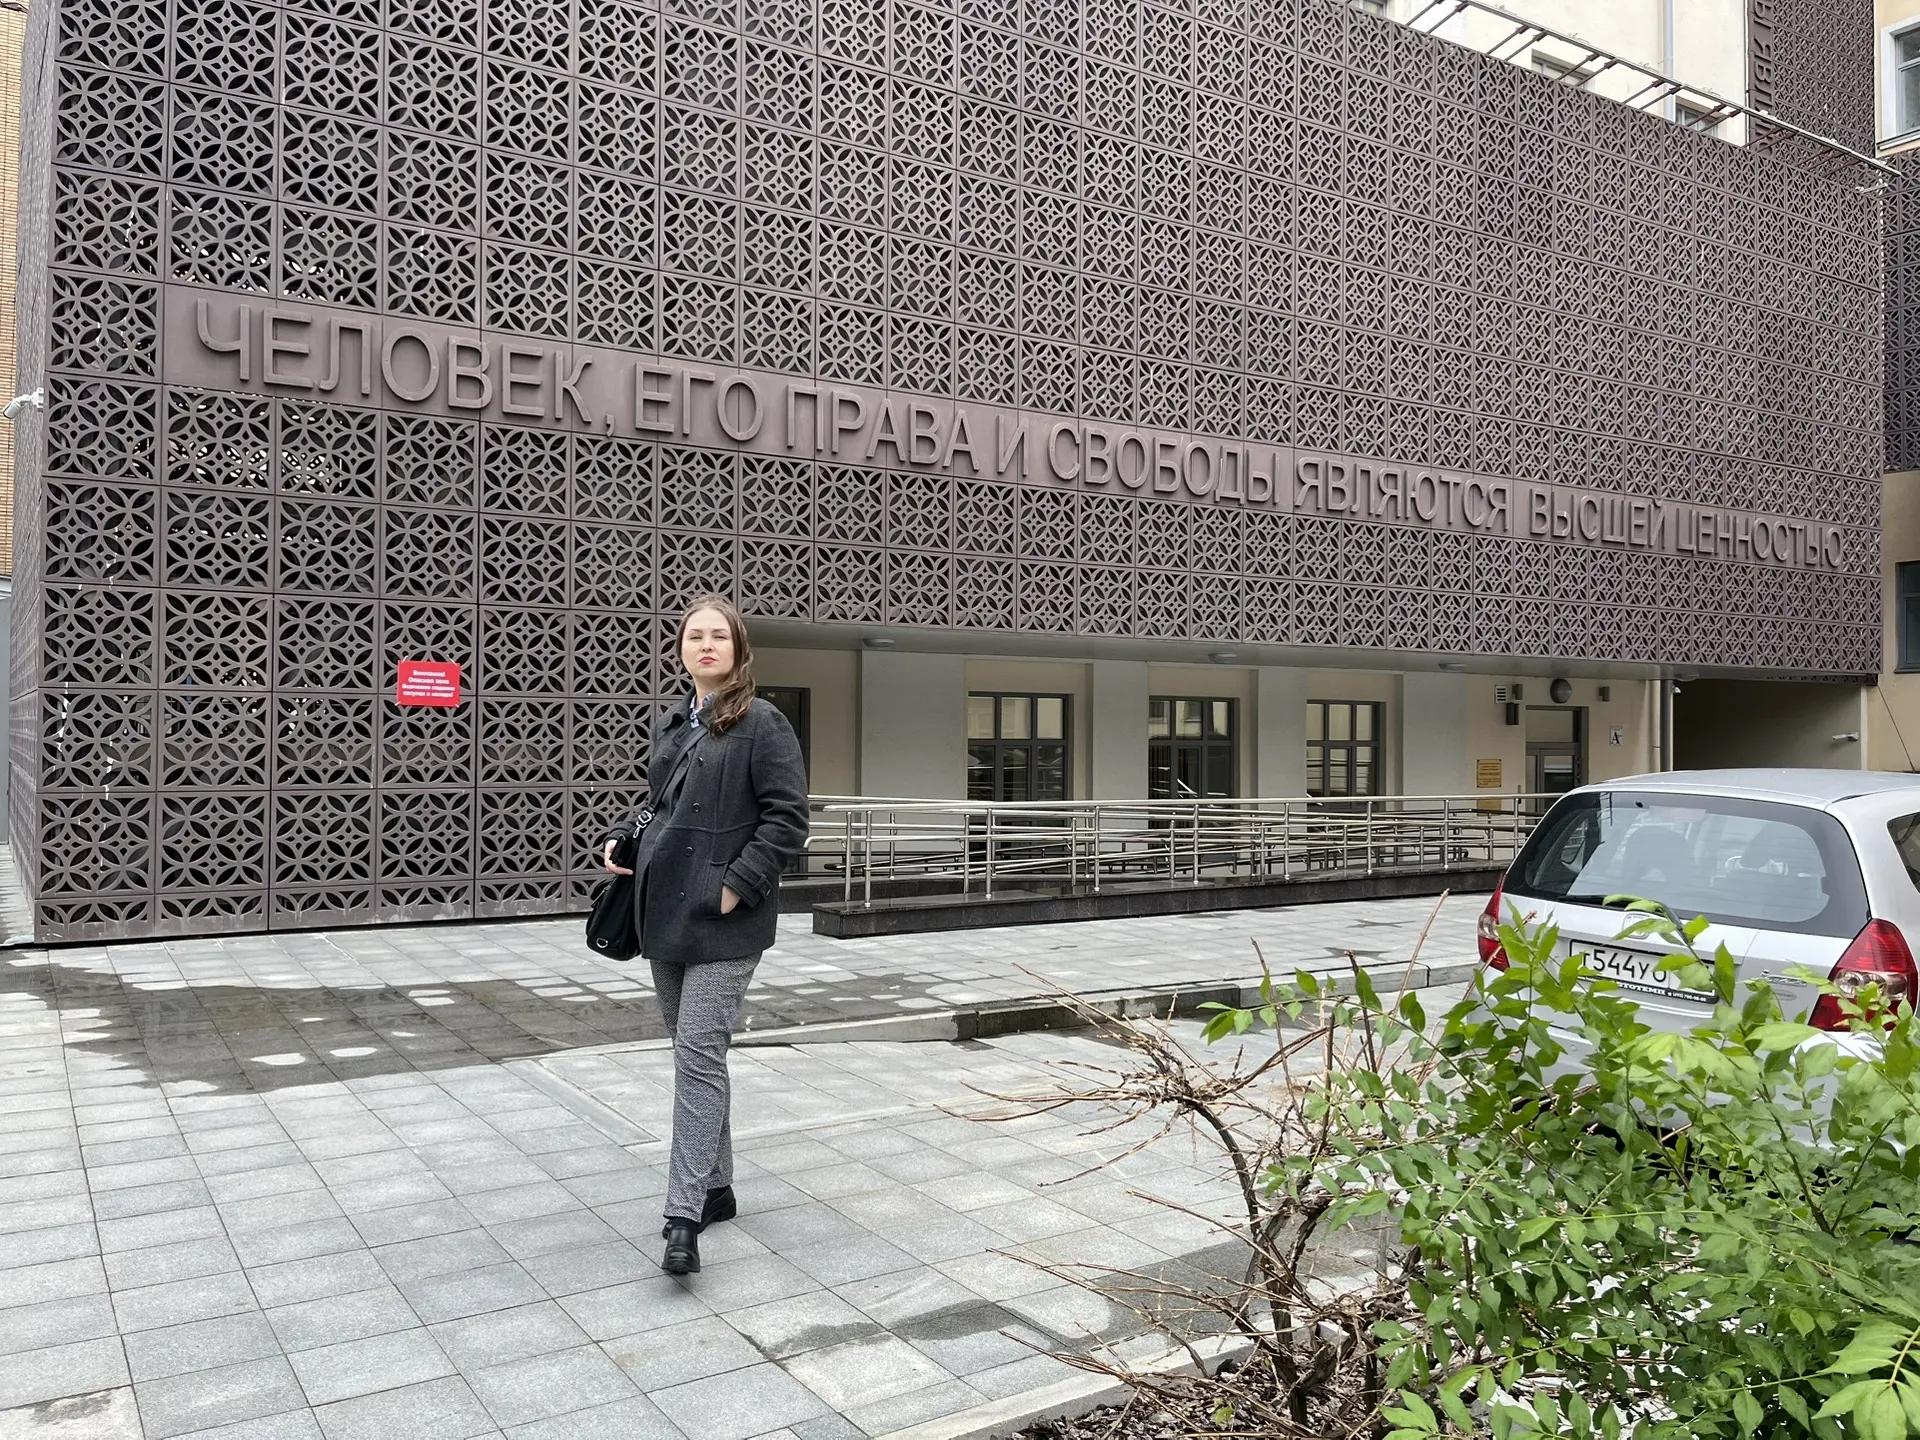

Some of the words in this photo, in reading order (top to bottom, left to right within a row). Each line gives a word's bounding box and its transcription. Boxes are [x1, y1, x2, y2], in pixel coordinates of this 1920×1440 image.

[197, 298, 615, 437] ЧЕЛОВЕК,
[634, 361, 764, 441] ЕГО
[786, 383, 980, 472] ПРАВА
[997, 414, 1030, 476] И
[1049, 422, 1280, 506] СВОБОДЫ
[1295, 456, 1509, 532] ЯВЛЯЮТСЯ
[1529, 487, 1666, 549] ВЫСШЕЙ
[1676, 506, 1843, 568] ЦЕННОСТЬЮ
